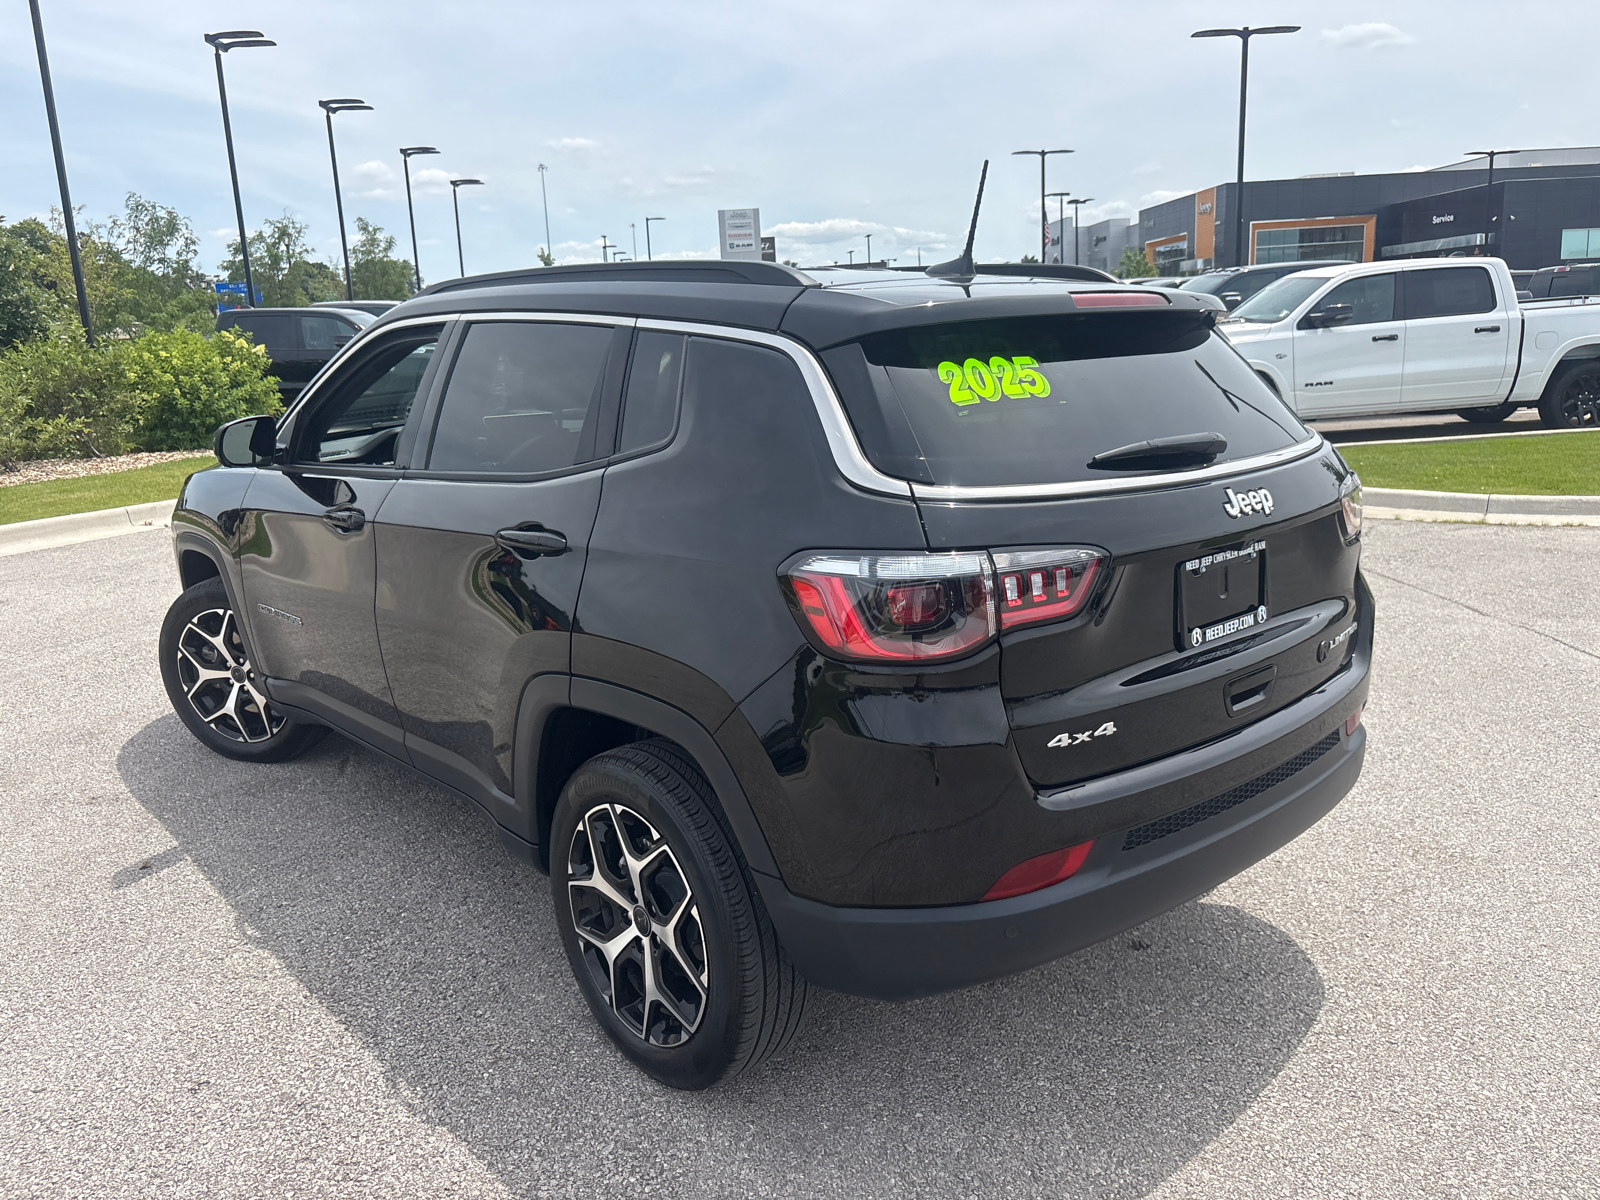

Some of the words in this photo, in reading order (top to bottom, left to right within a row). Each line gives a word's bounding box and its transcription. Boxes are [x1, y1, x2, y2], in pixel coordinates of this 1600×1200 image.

[1198, 202, 1212, 215] Jeep
[1432, 213, 1454, 225] Service
[937, 356, 1051, 406] 2025
[1222, 487, 1274, 518] Jeep
[1186, 560, 1200, 571] REED
[1201, 555, 1213, 568] JEEP
[1213, 550, 1239, 563] CHRYSLER
[1254, 540, 1266, 552] RAM
[1205, 614, 1254, 641] REEDJEEP.COM
[1046, 721, 1117, 748] 4x4
